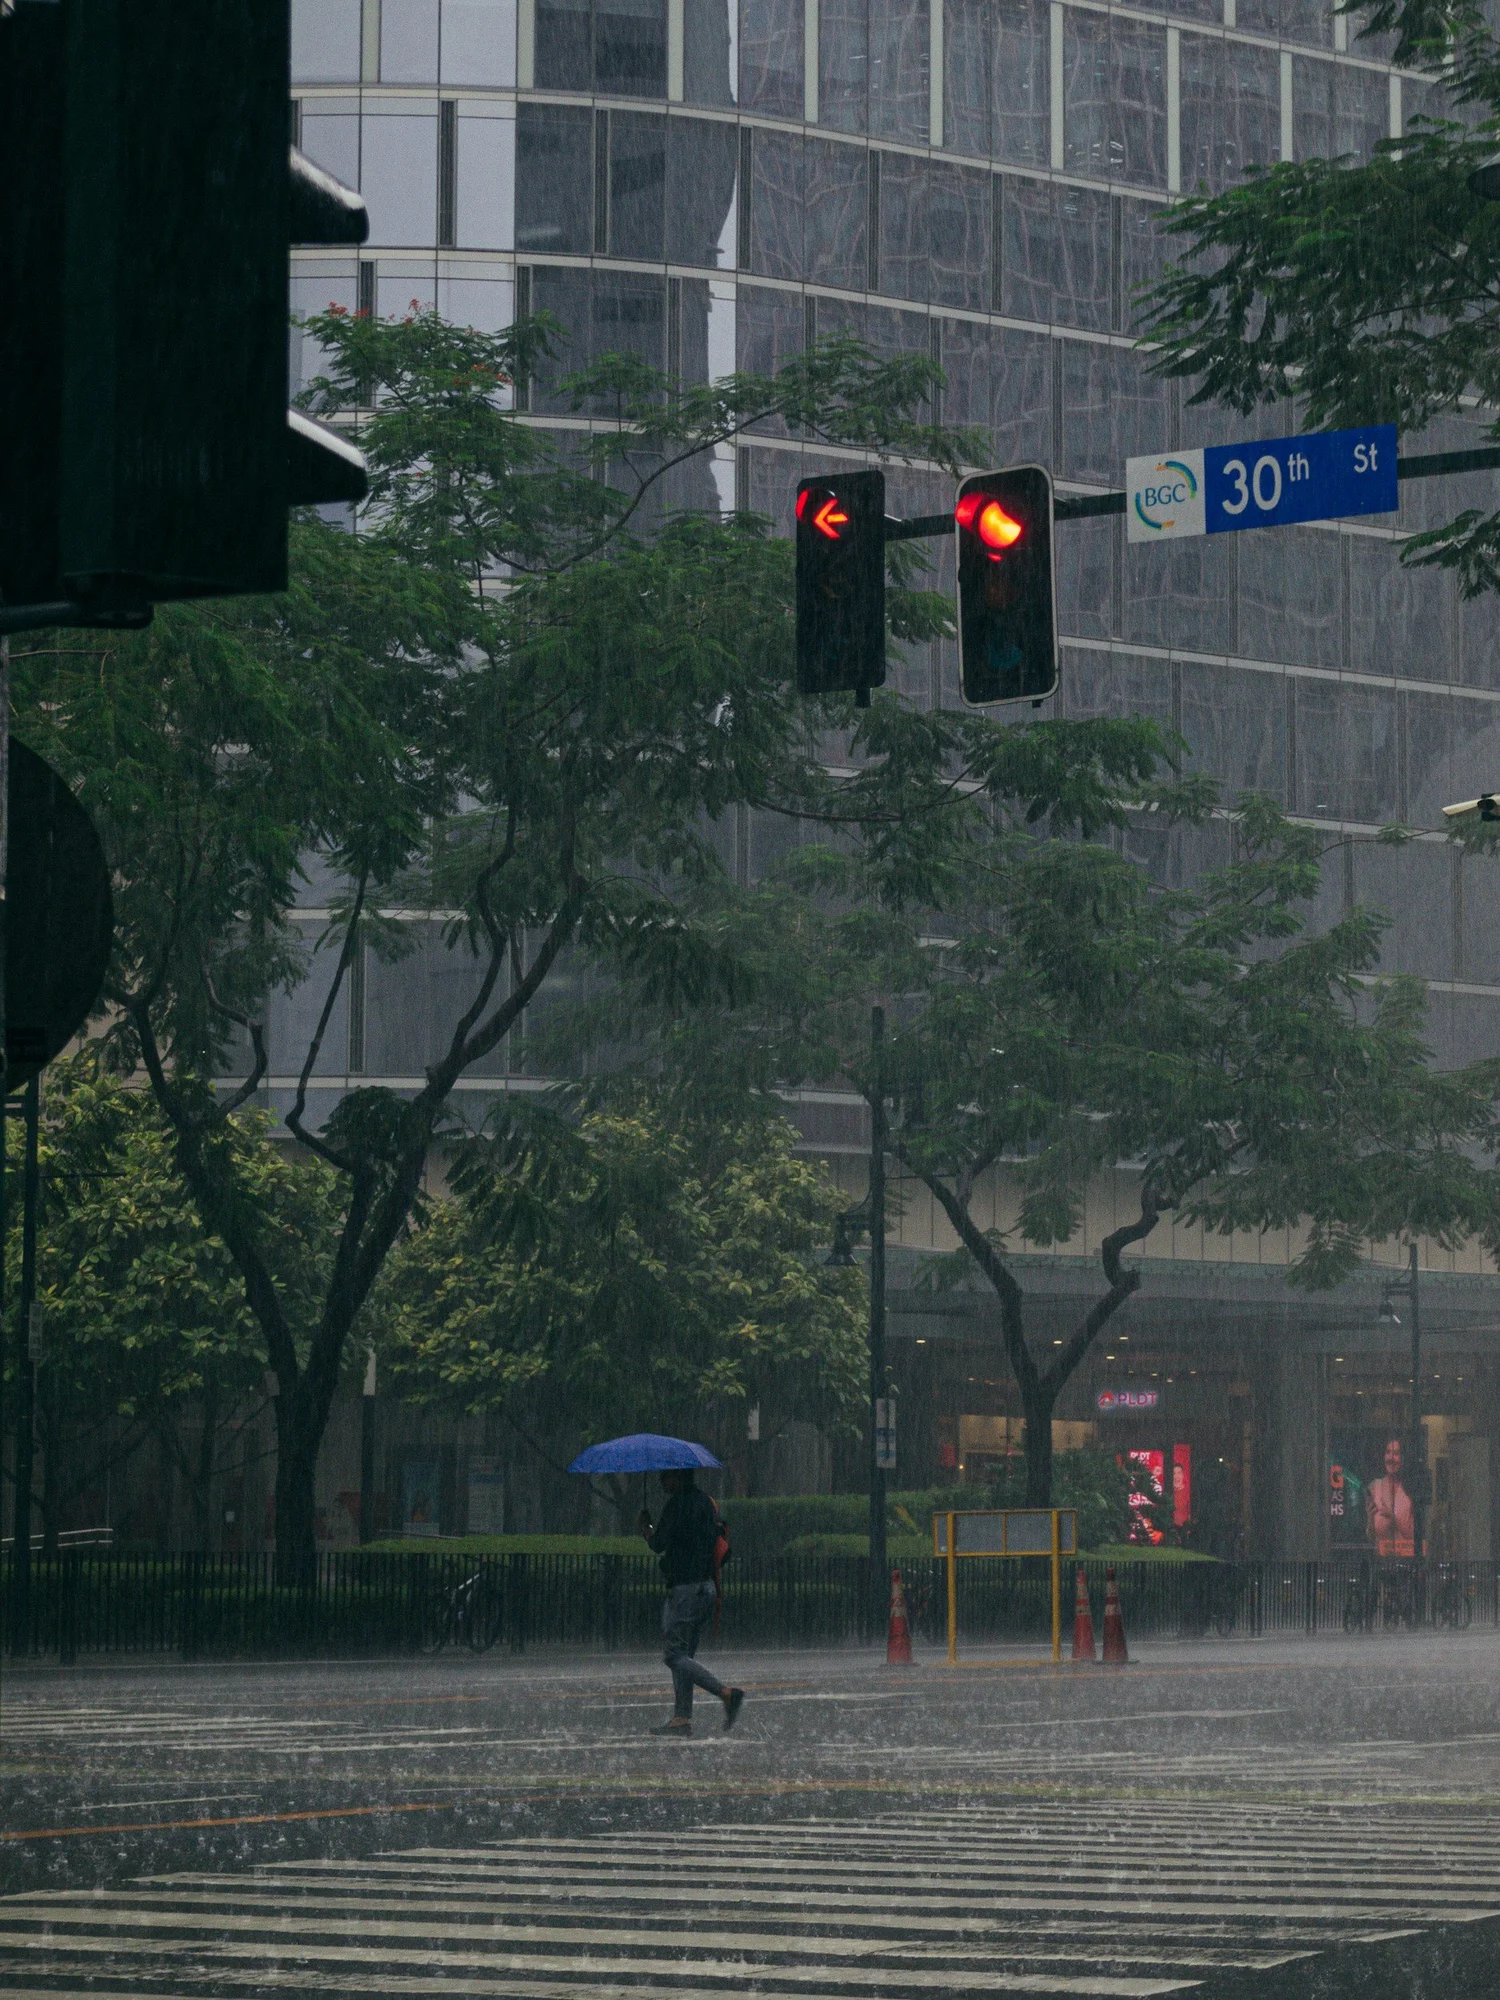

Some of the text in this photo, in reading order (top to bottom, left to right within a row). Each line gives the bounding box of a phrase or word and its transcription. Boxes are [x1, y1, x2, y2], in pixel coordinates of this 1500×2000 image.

[1353, 442, 1379, 474] St
[1144, 483, 1187, 508] BGC
[1117, 1392, 1158, 1406] PLDT
